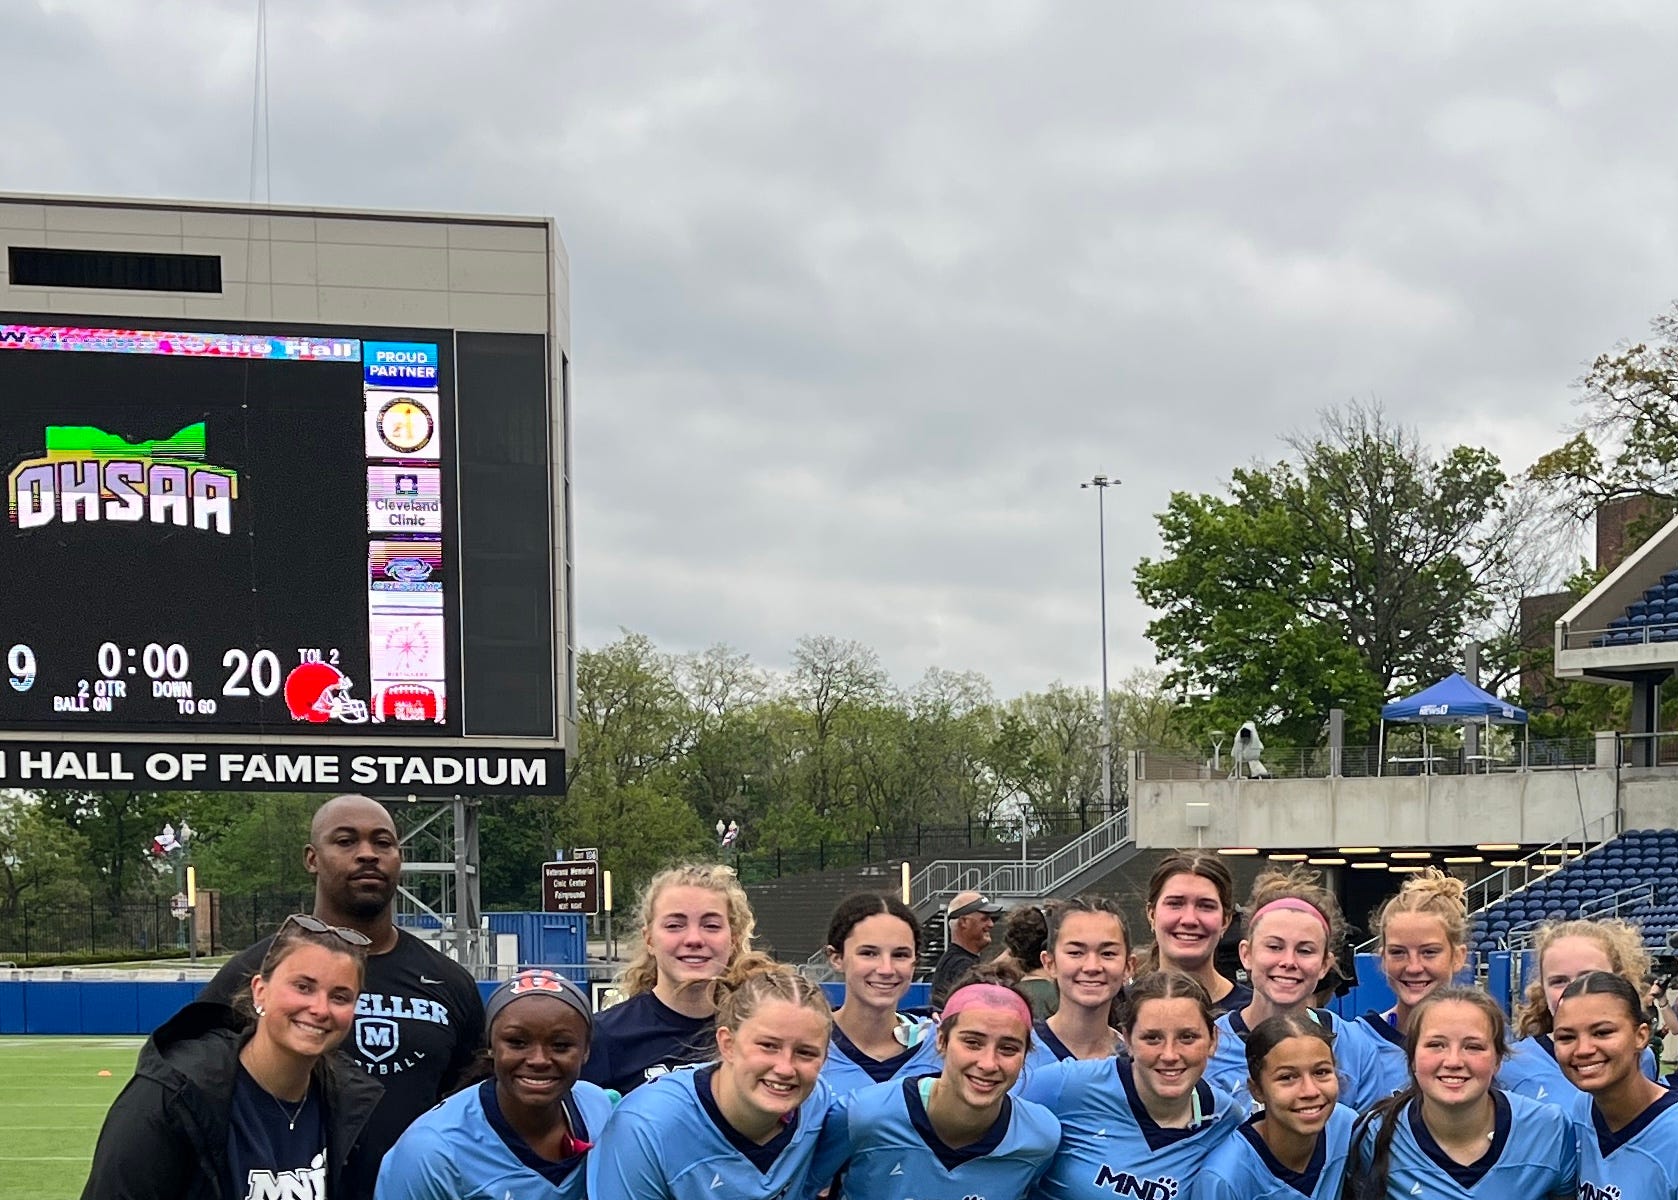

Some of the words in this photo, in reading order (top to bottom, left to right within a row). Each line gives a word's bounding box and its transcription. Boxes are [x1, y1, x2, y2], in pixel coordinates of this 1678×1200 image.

[284, 341, 352, 358] Hall
[376, 351, 428, 363] PROUD
[369, 365, 436, 378] PARTNER
[16, 459, 232, 534] OHSAA
[375, 499, 439, 512] Cleveland
[388, 514, 426, 526] Clinic
[97, 642, 189, 679] 0:00
[298, 649, 323, 665] TOL
[329, 649, 340, 665] 2
[7, 644, 37, 692] 9
[222, 649, 281, 697] 20
[77, 680, 90, 698] 2
[94, 681, 127, 698] QTR
[152, 681, 193, 698] DOWN
[53, 696, 89, 712] BALL
[93, 697, 113, 712] ON
[176, 699, 194, 714] TO
[198, 699, 217, 714] GO
[19, 752, 135, 781] HALL
[145, 753, 207, 782] OF
[219, 755, 341, 784] FAME
[350, 755, 547, 787] STADIUM
[354, 993, 449, 1026] ELLER
[364, 1026, 391, 1047] M
[354, 1051, 426, 1075] TBALL
